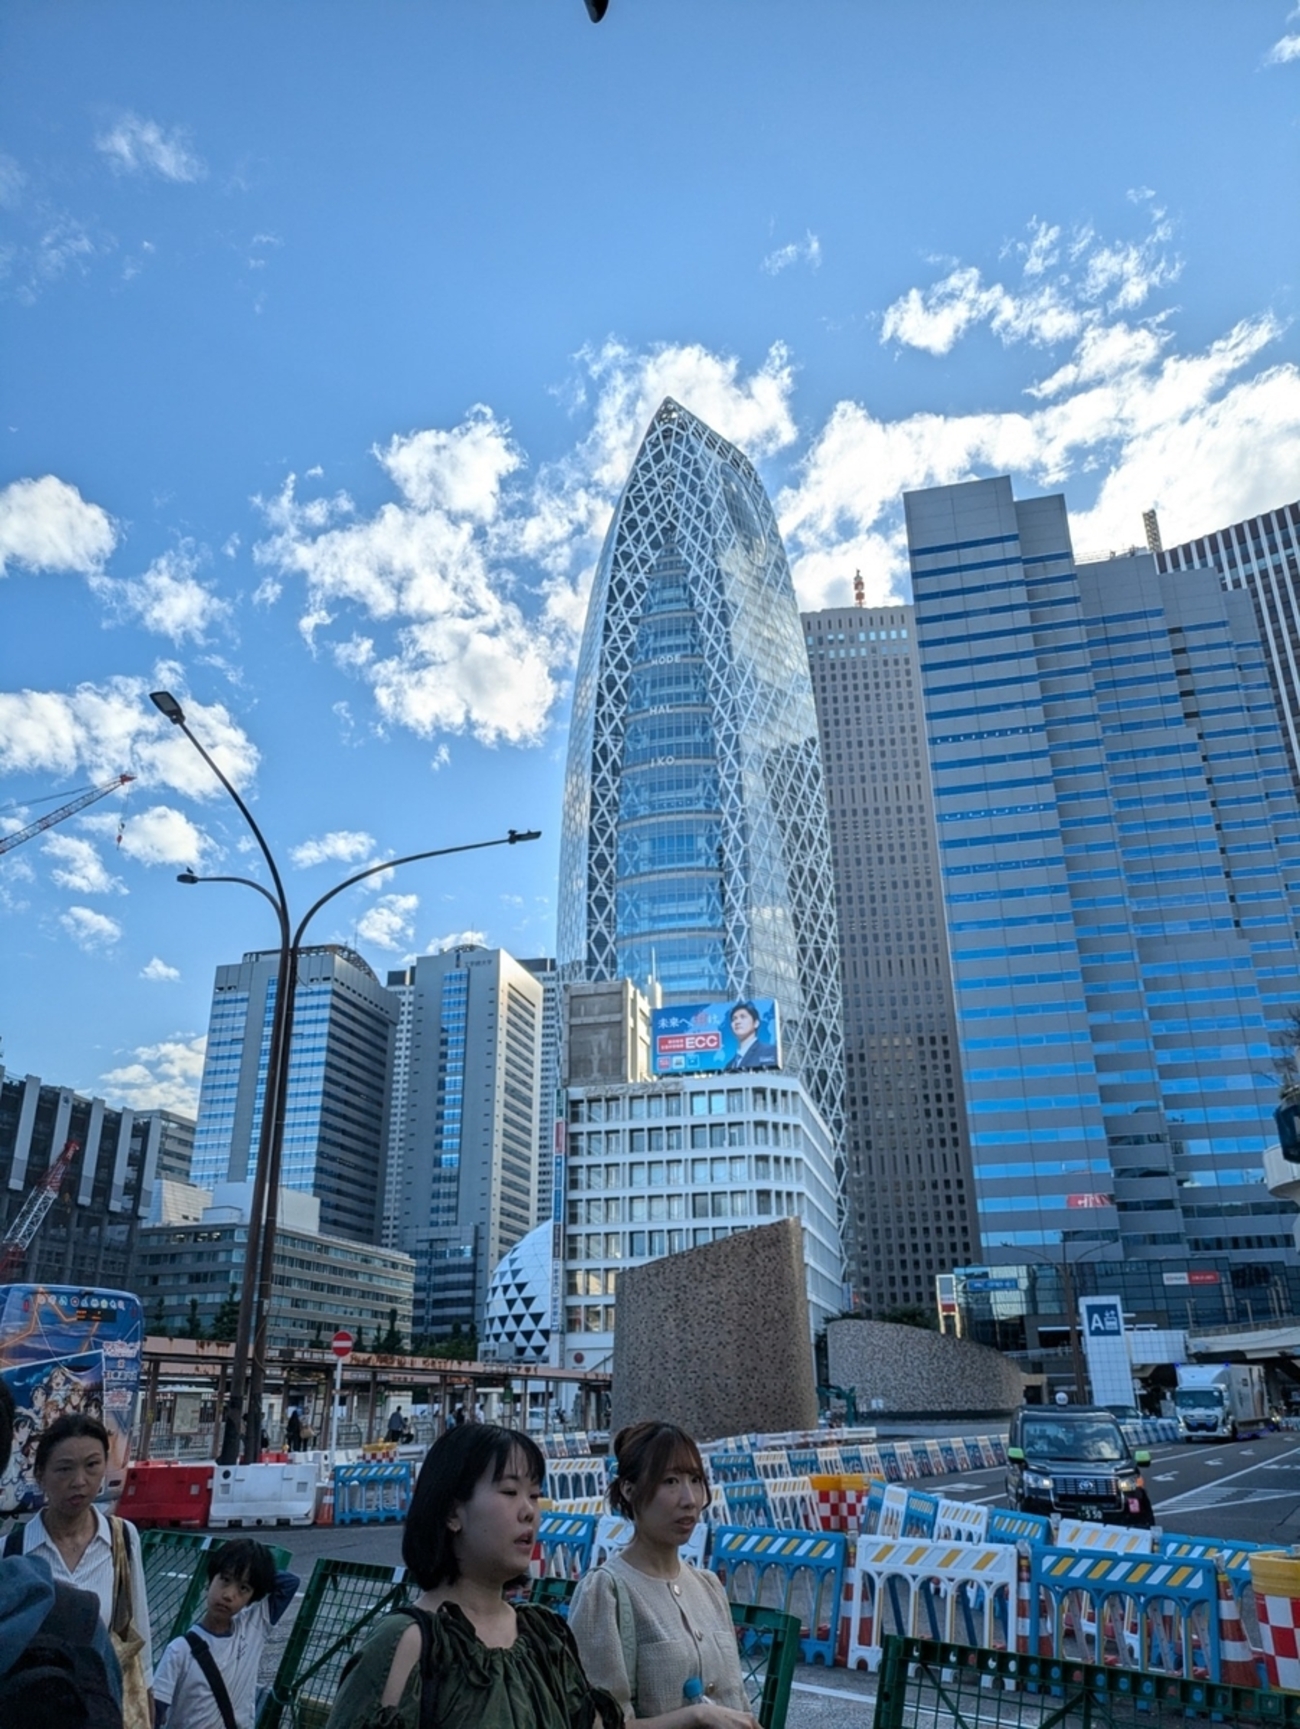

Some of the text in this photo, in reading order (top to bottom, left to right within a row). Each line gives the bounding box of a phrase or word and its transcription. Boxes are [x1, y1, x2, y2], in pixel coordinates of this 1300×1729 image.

[650, 704, 673, 715] HAL
[685, 1035, 718, 1049] ECC
[1091, 1313, 1104, 1331] A
